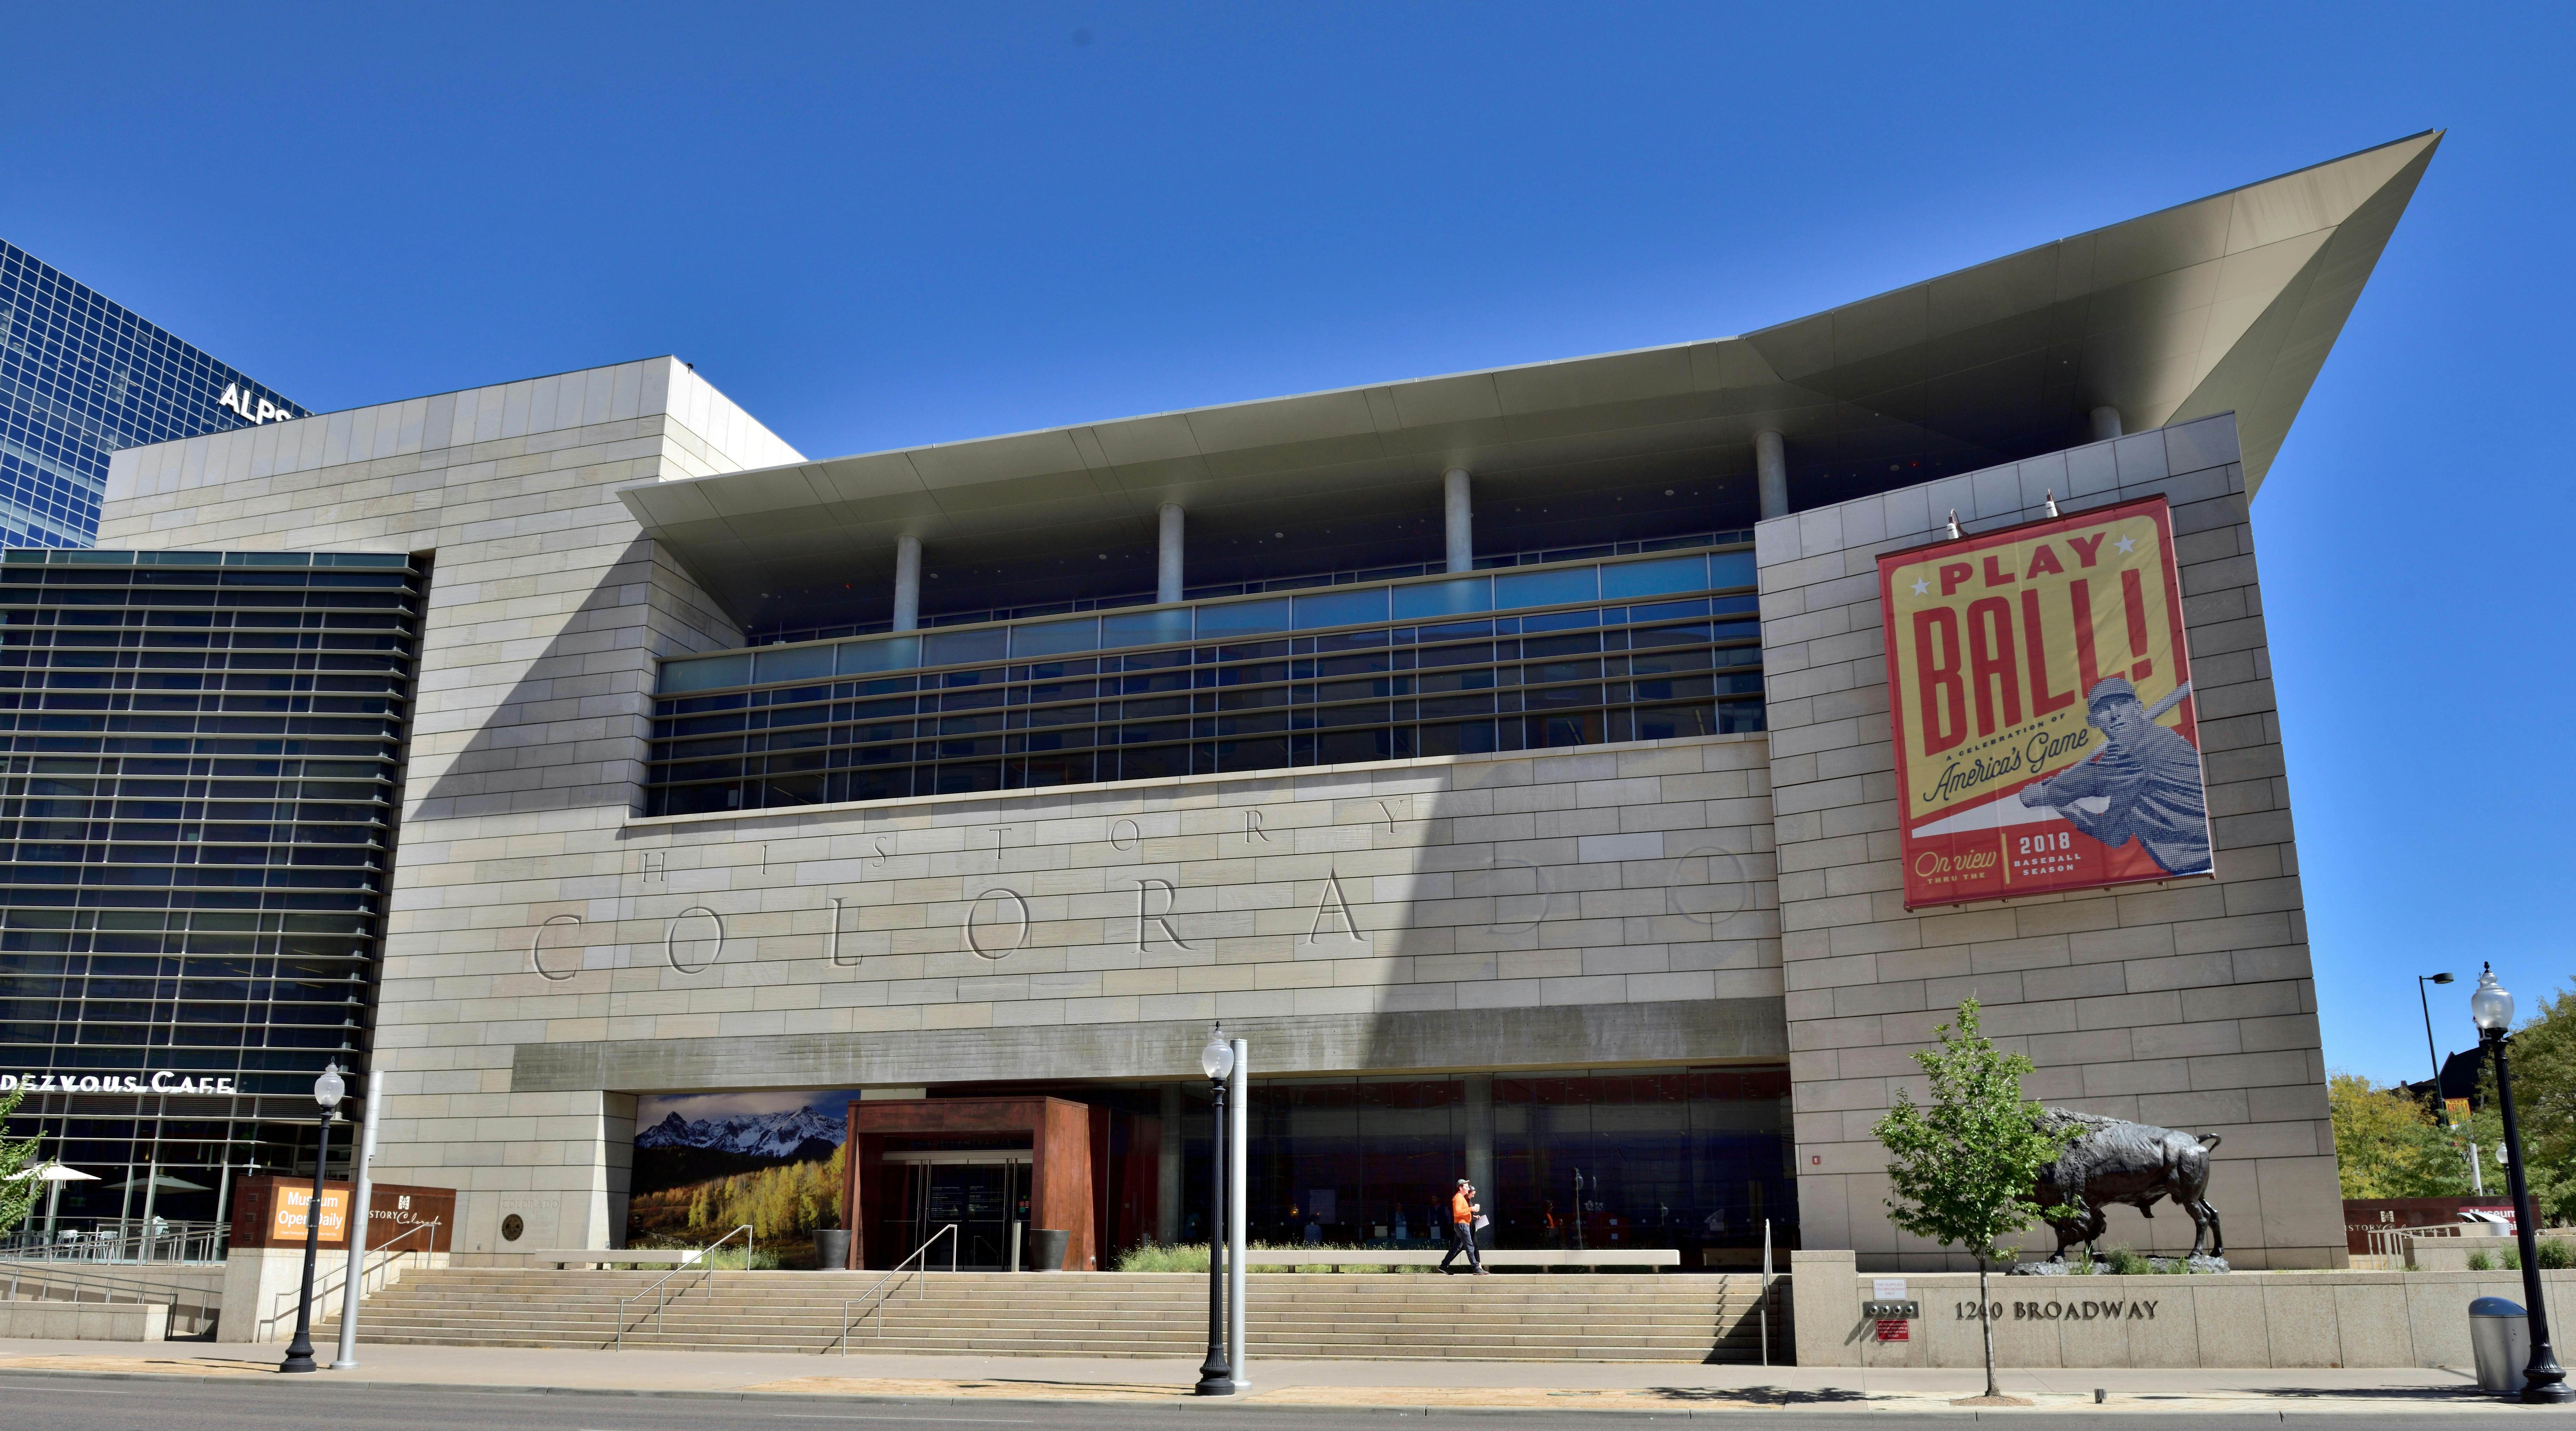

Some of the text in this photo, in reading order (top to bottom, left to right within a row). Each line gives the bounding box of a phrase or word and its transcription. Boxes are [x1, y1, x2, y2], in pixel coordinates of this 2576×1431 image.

[1939, 532, 2106, 596] PLAY
[1913, 569, 2153, 757] BALL!
[1959, 721, 2044, 756] CELEBRATION
[2051, 713, 2065, 723] OF
[1923, 728, 2089, 802] America's Game
[641, 799, 1404, 883] HISTORY
[2020, 832, 2070, 854] 2018
[1915, 849, 1996, 877] On view
[2014, 854, 2081, 867] BASEBALL
[2023, 865, 2074, 875] SEASON
[1927, 875, 1957, 884] THRU
[531, 847, 1747, 982] COLORADO
[151, 1071, 233, 1094] CAFE
[288, 1192, 338, 1207] Musum
[369, 1210, 442, 1225] STORY Colorado
[2014, 1301, 2158, 1319] BROADWAY
